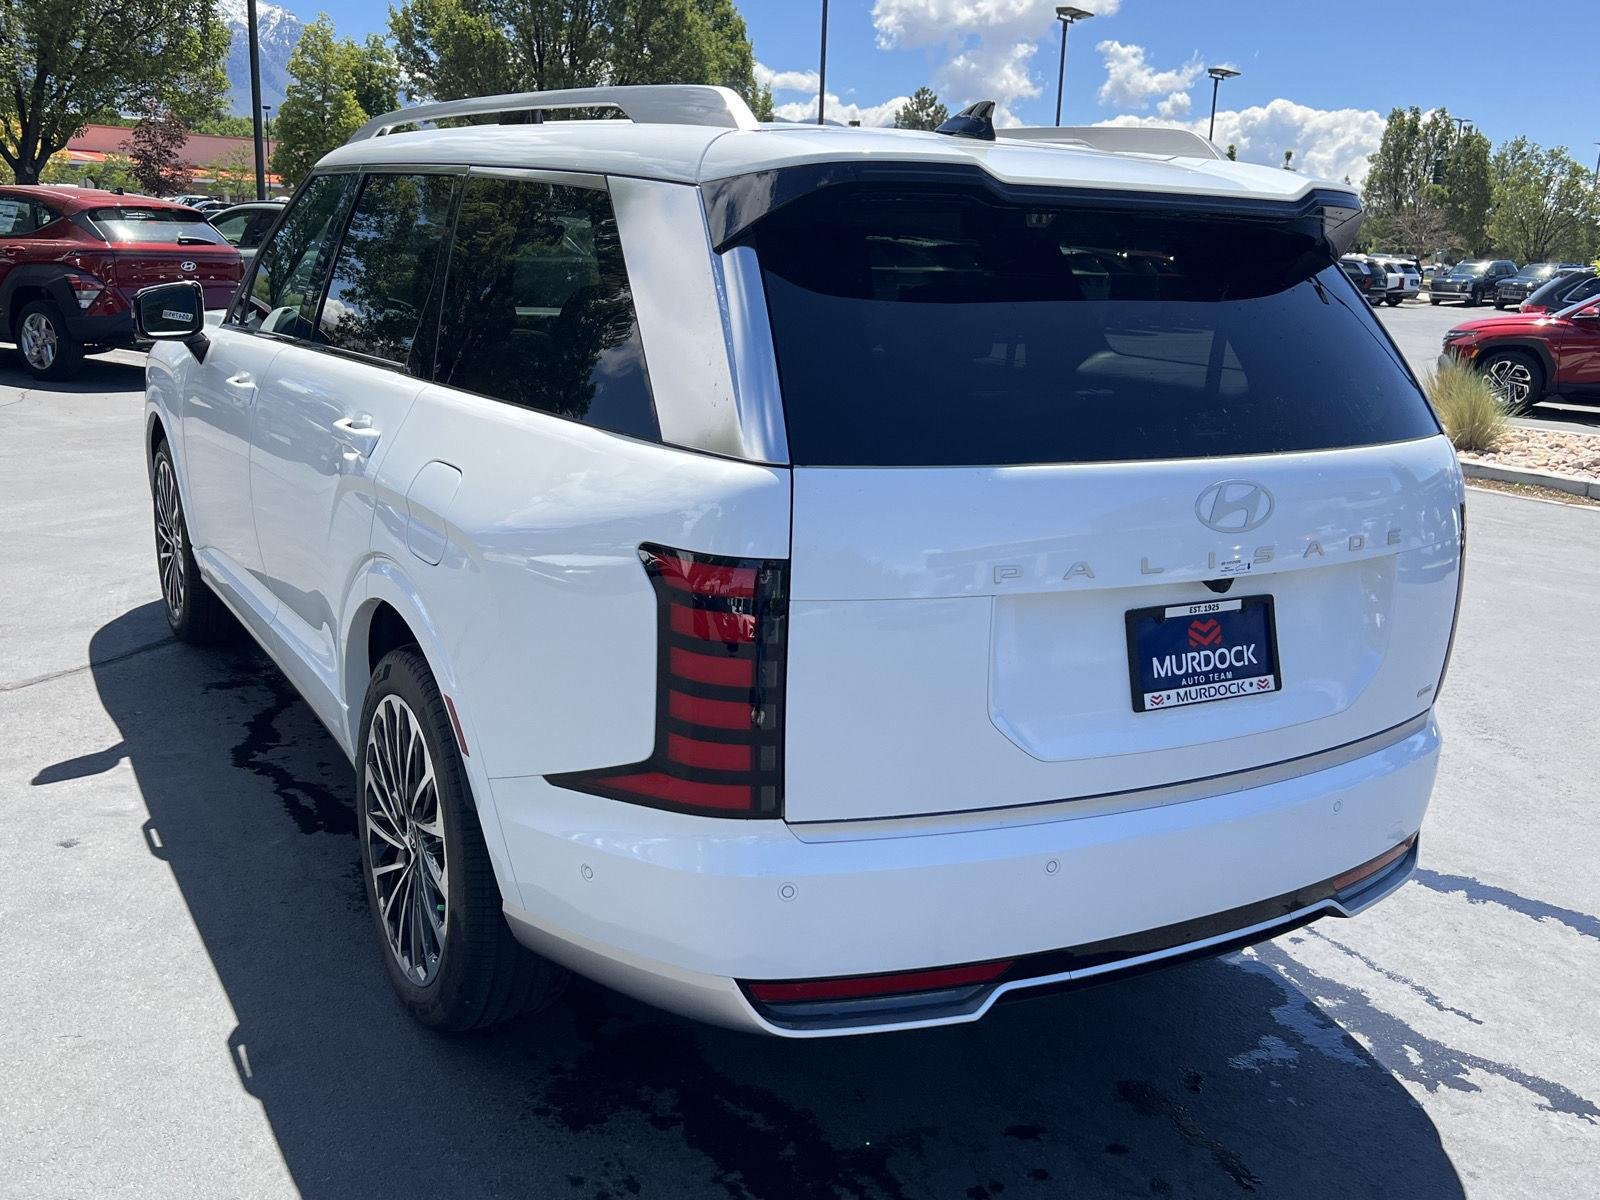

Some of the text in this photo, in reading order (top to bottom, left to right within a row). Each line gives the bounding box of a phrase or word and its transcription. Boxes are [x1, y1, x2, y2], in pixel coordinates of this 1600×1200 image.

[993, 528, 1402, 584] PALISADE
[1189, 603, 1220, 614] EST. 1925
[1152, 643, 1258, 679] MURDOCK
[1181, 671, 1233, 686] AUTO TEAM
[1176, 681, 1247, 703] MURDOCK
